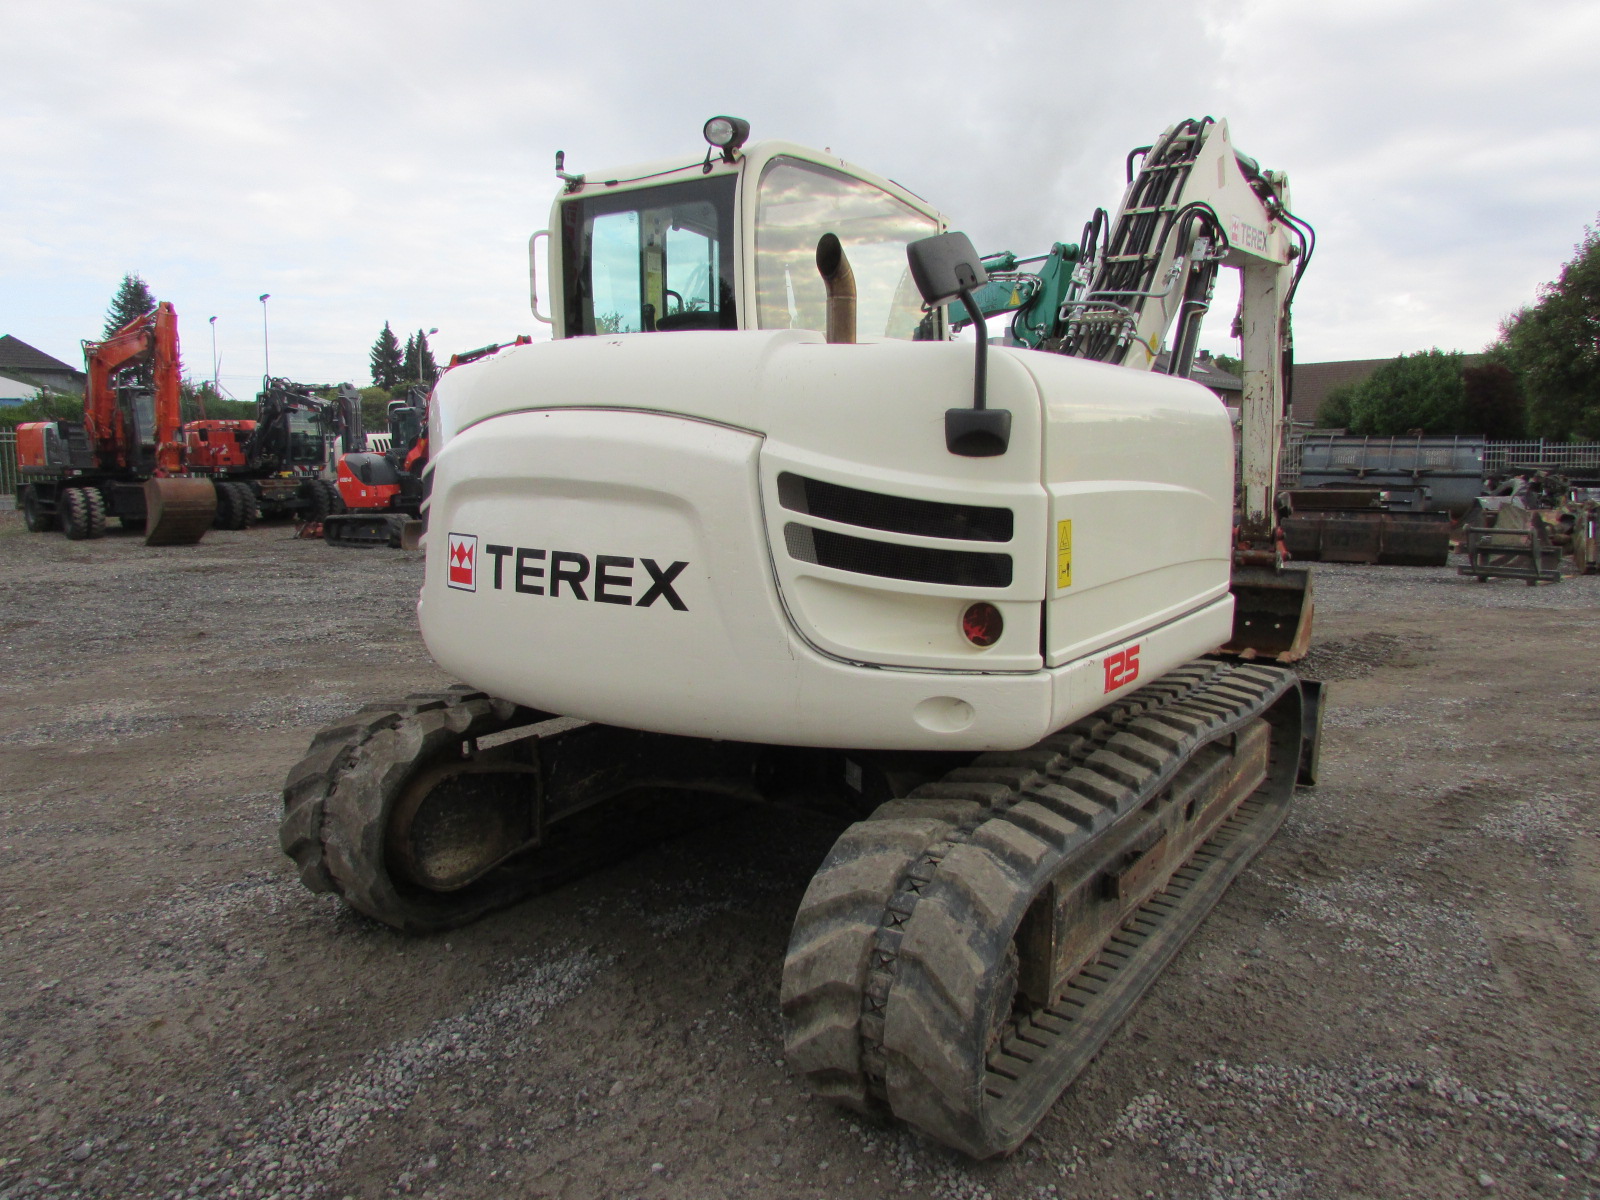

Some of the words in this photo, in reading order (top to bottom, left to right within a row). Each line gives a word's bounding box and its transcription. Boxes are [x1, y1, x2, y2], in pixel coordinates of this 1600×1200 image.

[1242, 224, 1267, 252] TEREX
[486, 544, 689, 611] TEREX
[1104, 644, 1140, 694] 125
